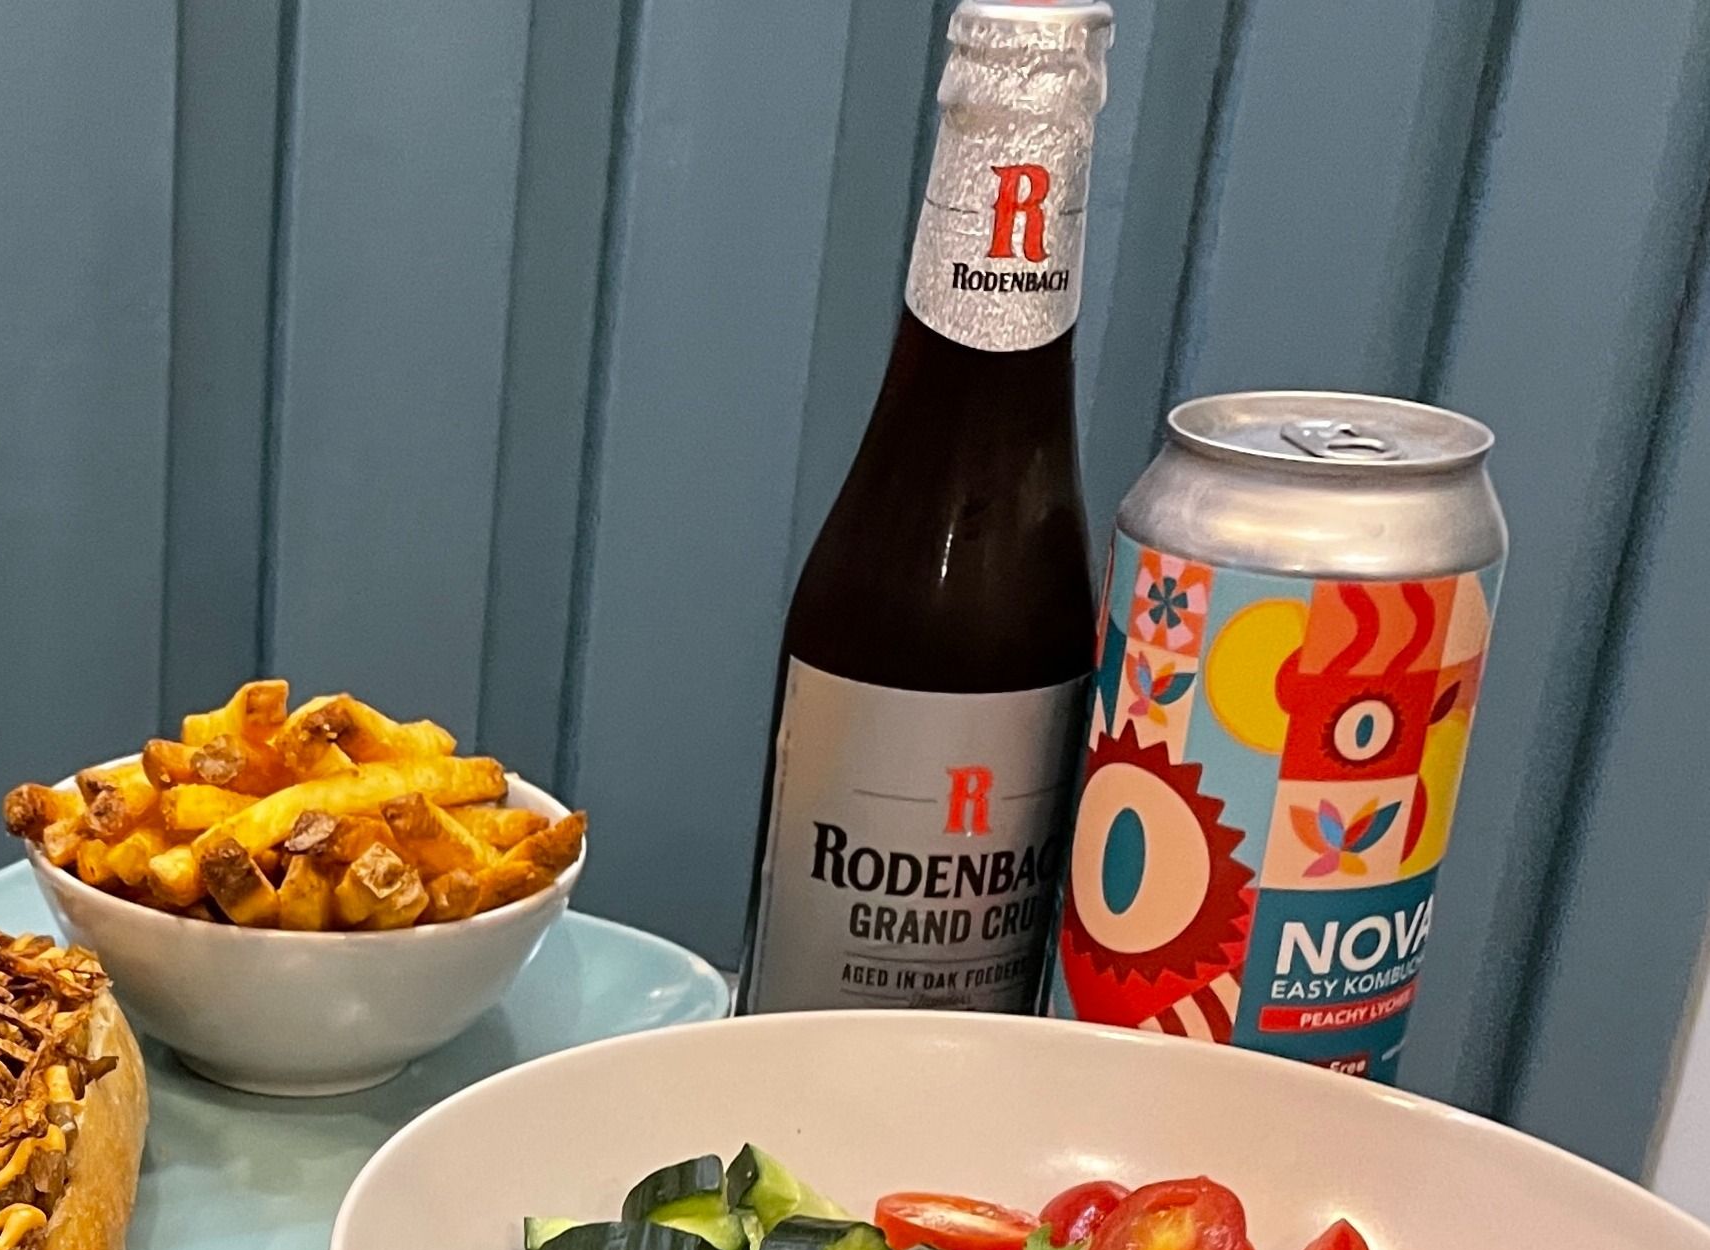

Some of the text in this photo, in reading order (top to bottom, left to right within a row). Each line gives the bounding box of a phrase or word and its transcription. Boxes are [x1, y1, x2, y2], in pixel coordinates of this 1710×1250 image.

[986, 163, 1050, 263] R
[951, 262, 1070, 292] RODENBACH
[942, 765, 994, 837] R
[848, 895, 1040, 946] GRAND CRU
[840, 962, 889, 988] AGED
[895, 969, 917, 991] IN
[923, 971, 958, 991] OAK
[1270, 954, 1424, 1001] EASY KOMBUC
[1299, 1006, 1369, 1029] PEACHY
